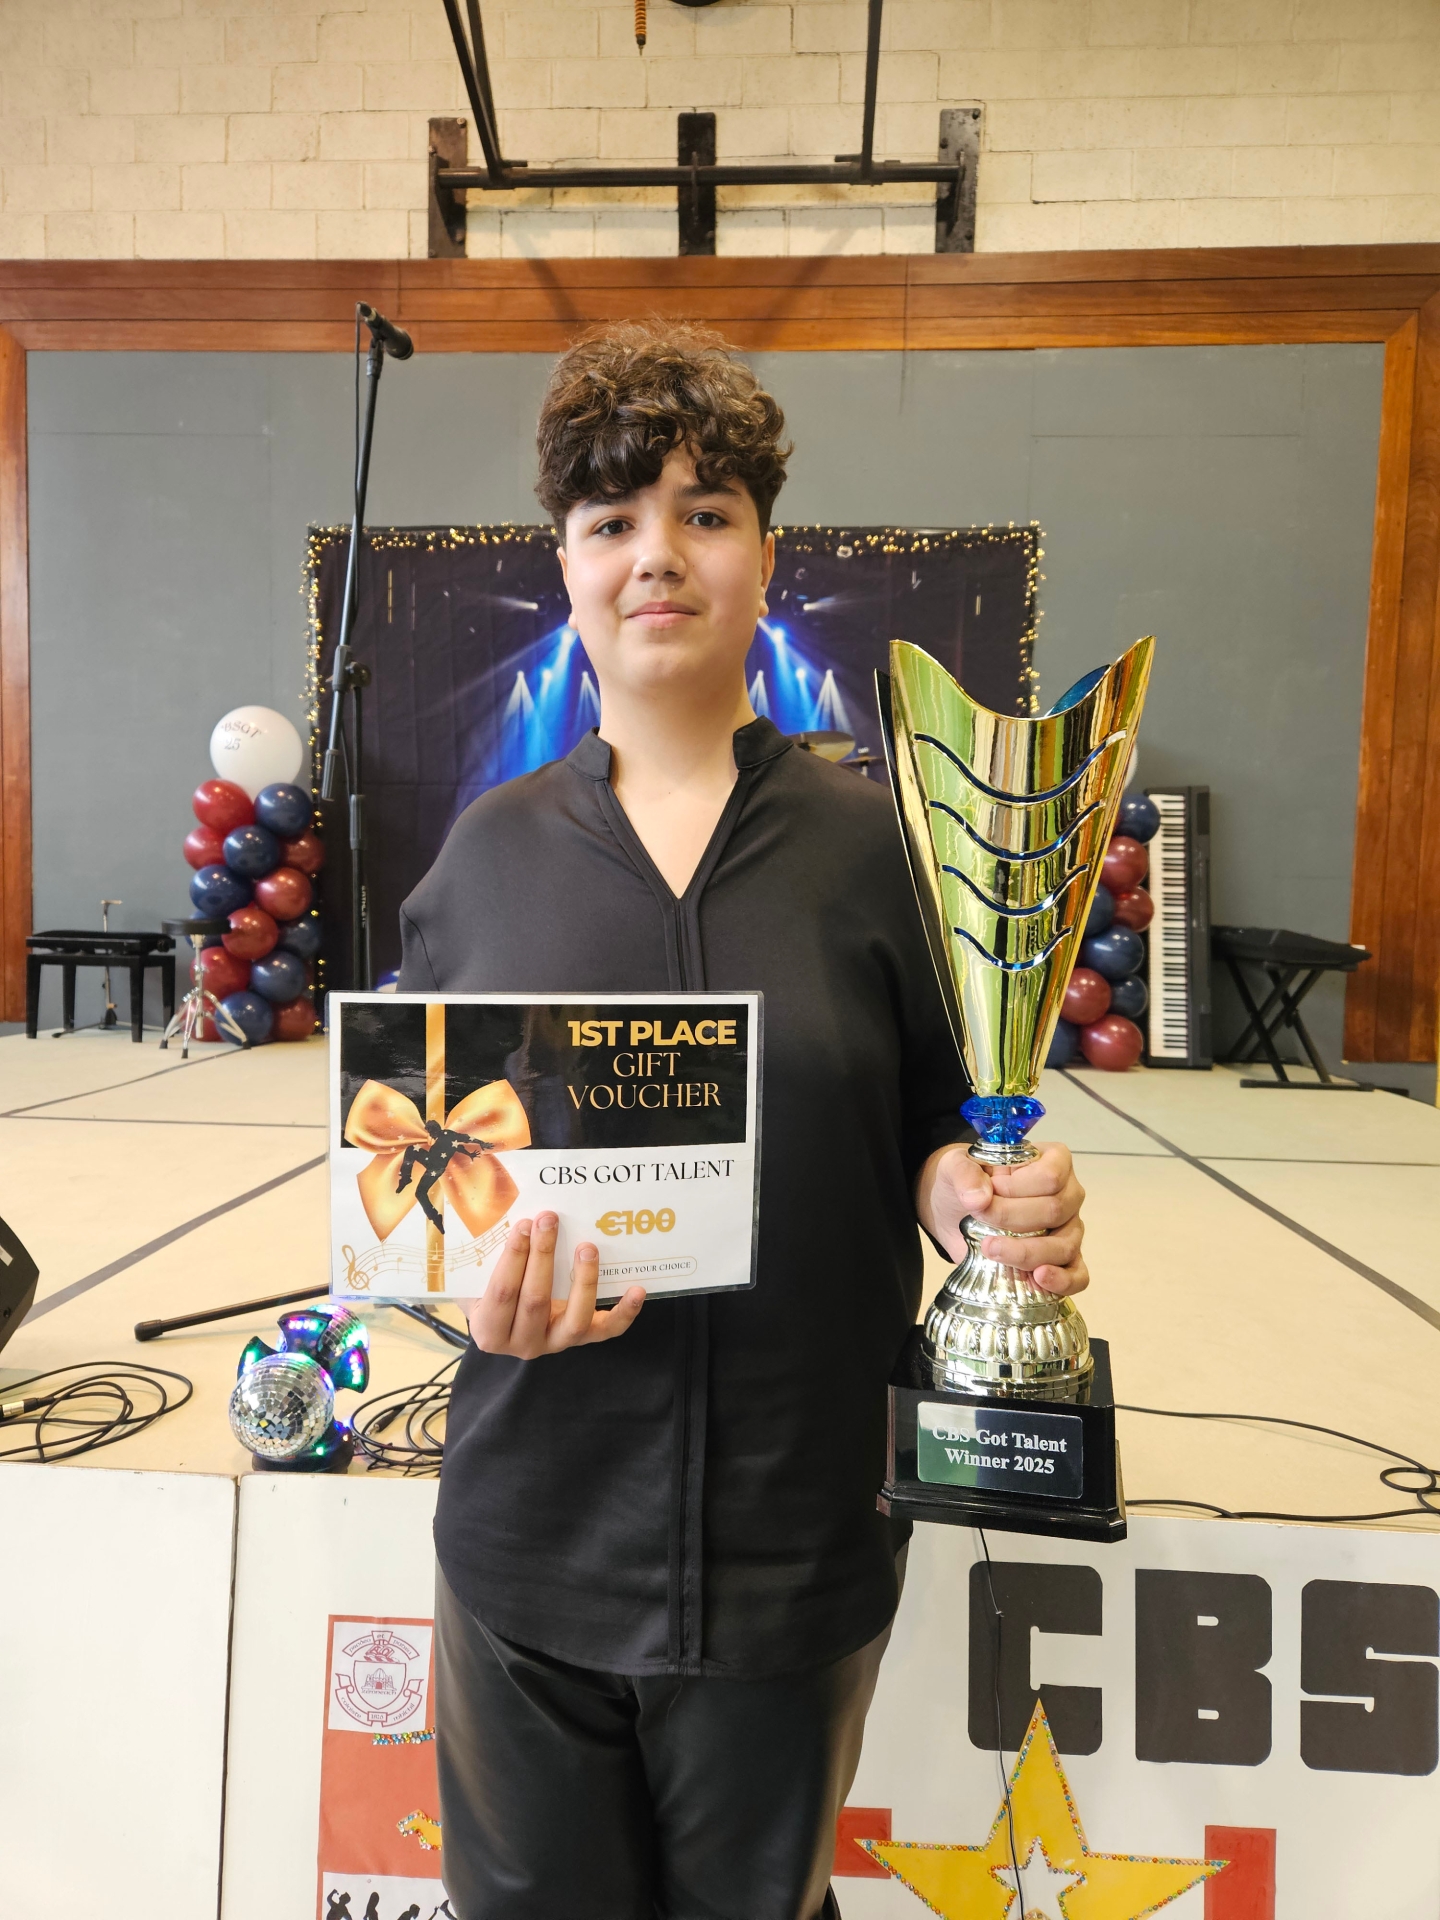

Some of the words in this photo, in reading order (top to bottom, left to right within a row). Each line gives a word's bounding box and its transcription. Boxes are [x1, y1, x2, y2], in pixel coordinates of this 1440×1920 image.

[223, 737, 241, 751] 25
[567, 1020, 624, 1047] 1ST
[630, 1019, 737, 1046] PLACE
[612, 1052, 681, 1078] GIFT
[566, 1082, 722, 1110] VOUCHER
[539, 1166, 587, 1186] CBS
[593, 1164, 646, 1184] GOT
[651, 1159, 735, 1182] TALENT
[594, 1207, 676, 1237] €100
[598, 1268, 620, 1277] CHER
[621, 1267, 632, 1275] OF
[634, 1265, 657, 1273] YOUR
[659, 1261, 691, 1271] CHOICE
[932, 1425, 971, 1443] CBS
[975, 1429, 1008, 1447] Got
[1011, 1432, 1068, 1453] Talent
[944, 1447, 1010, 1470] Winner
[1013, 1456, 1055, 1475] 2025
[968, 1560, 1440, 1777] CBS
